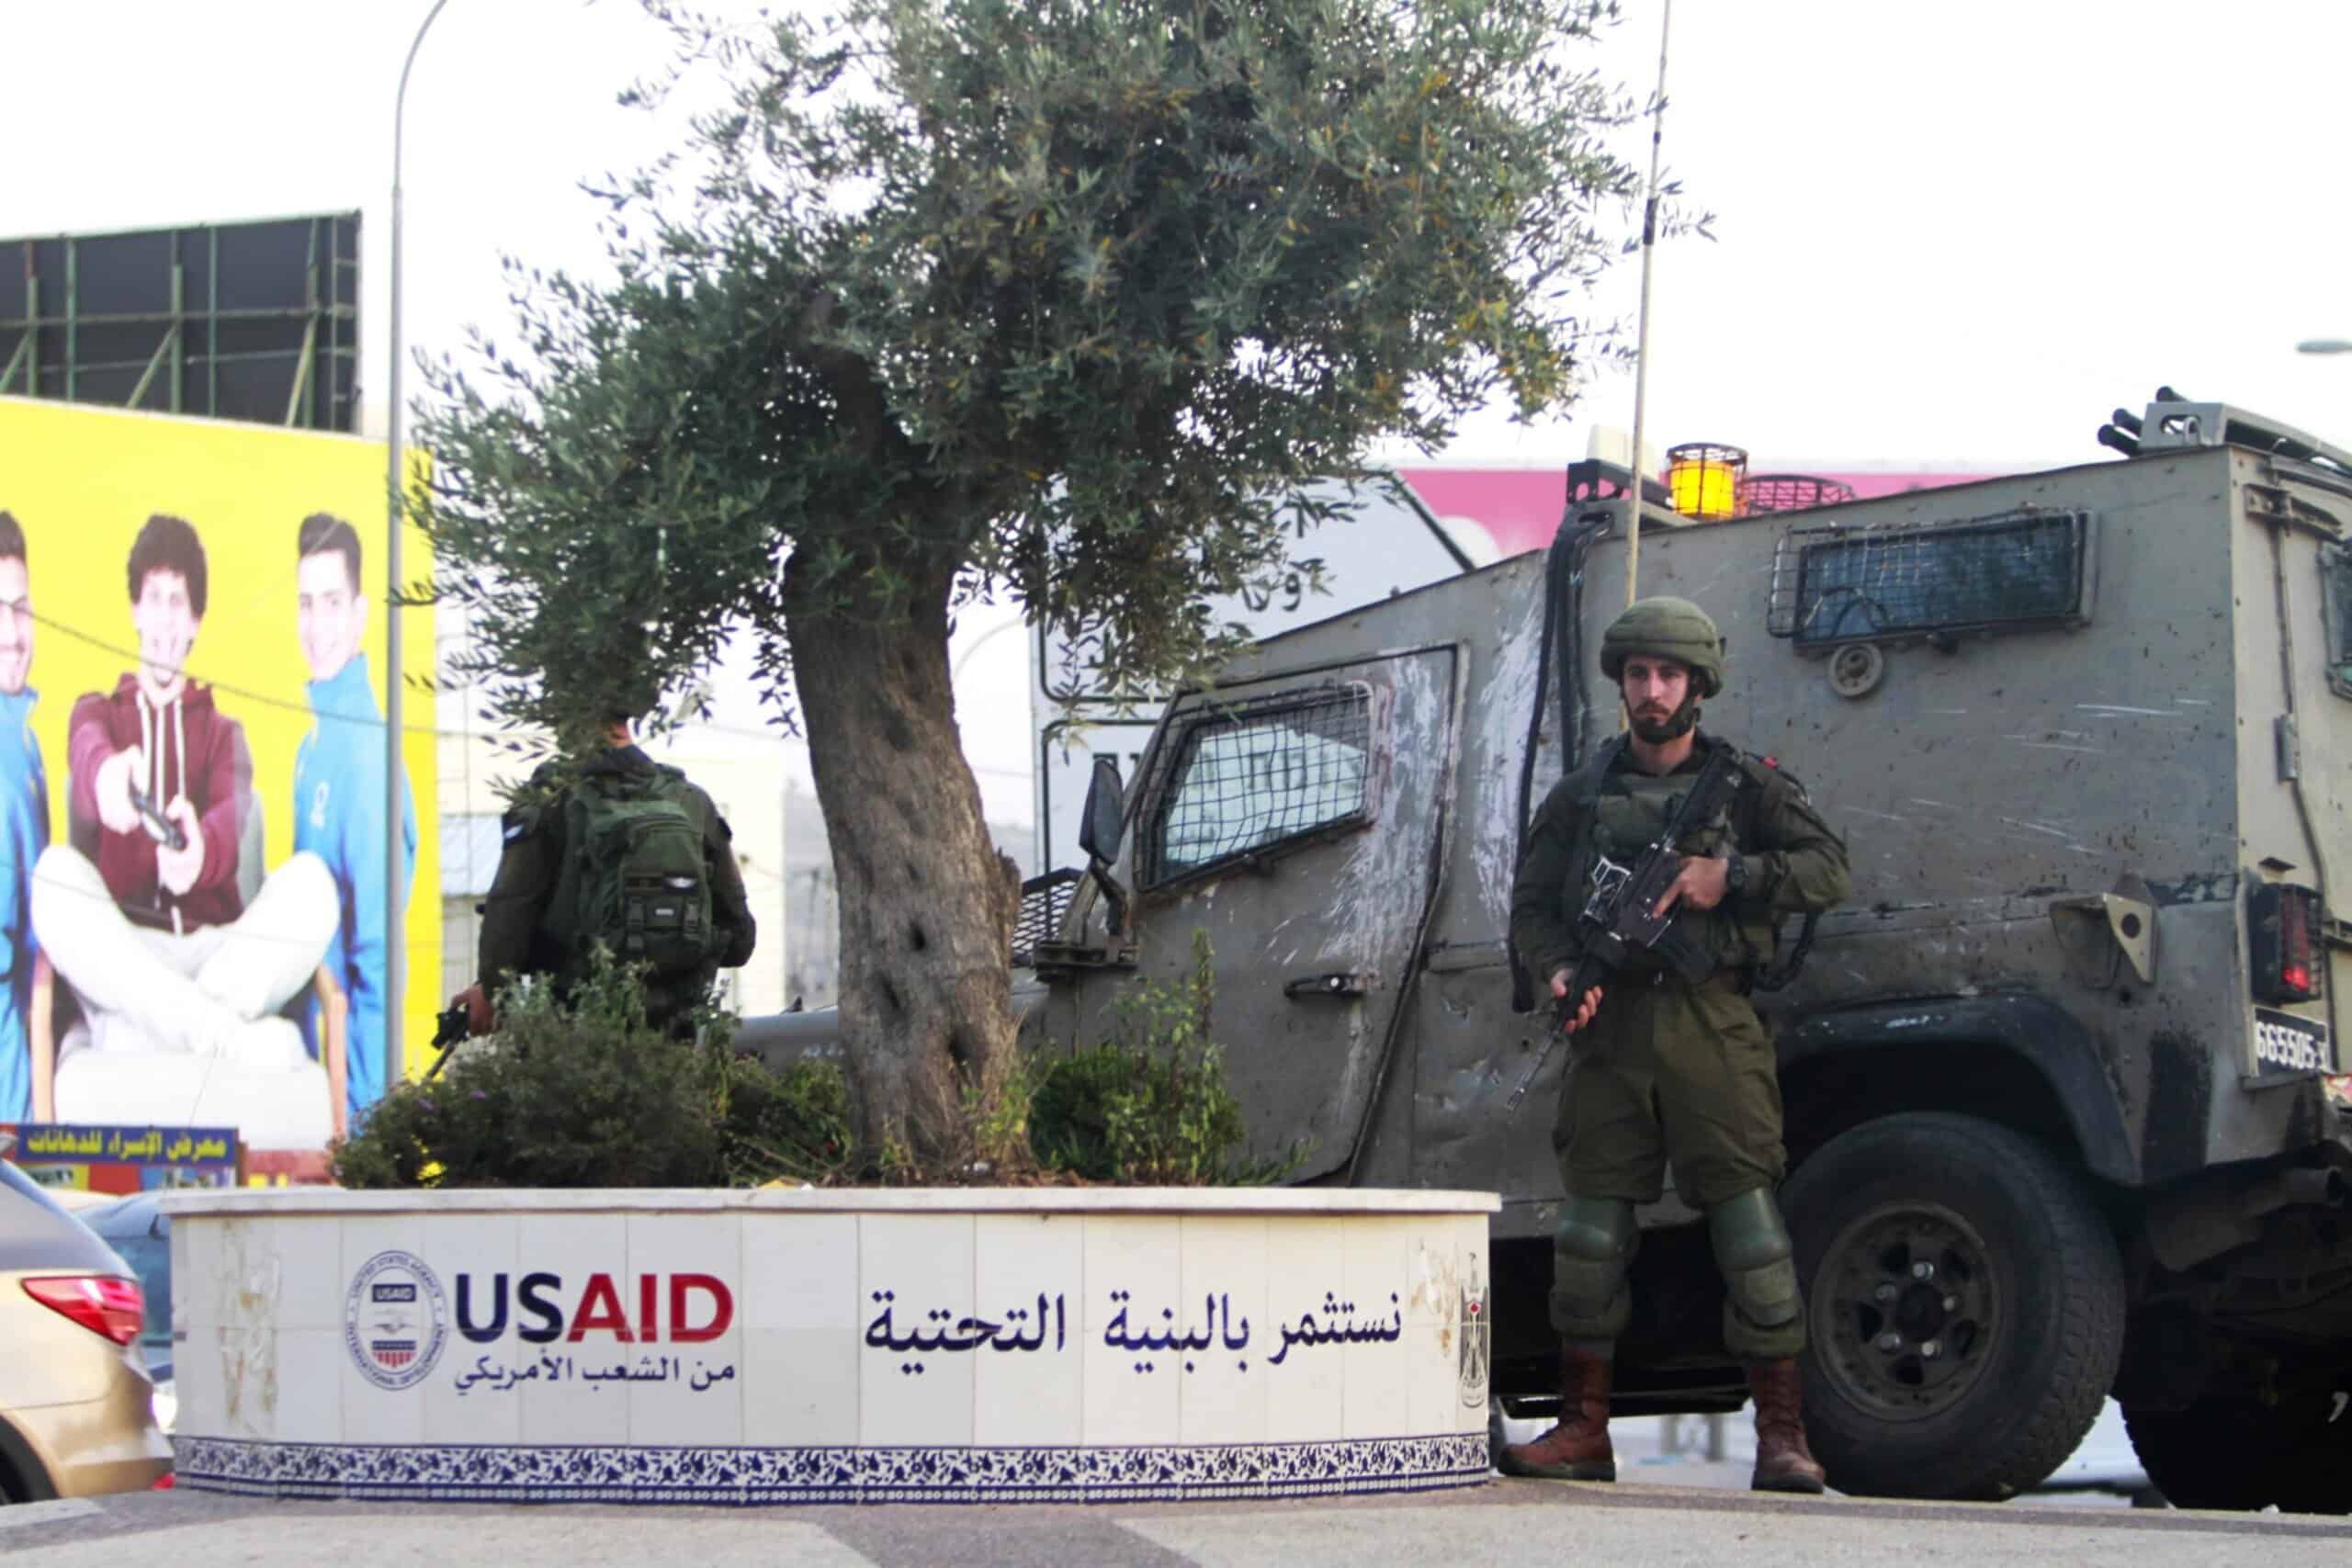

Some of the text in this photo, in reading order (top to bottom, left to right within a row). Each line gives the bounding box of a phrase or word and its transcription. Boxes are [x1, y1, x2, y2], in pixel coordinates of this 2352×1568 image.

[456, 1272, 735, 1345] USAID
[865, 1290, 1402, 1375] نستثمر بالبنية التحتية
[454, 1347, 573, 1395] الأمريكي
[581, 1356, 680, 1392] الشعب
[690, 1360, 736, 1392] من
